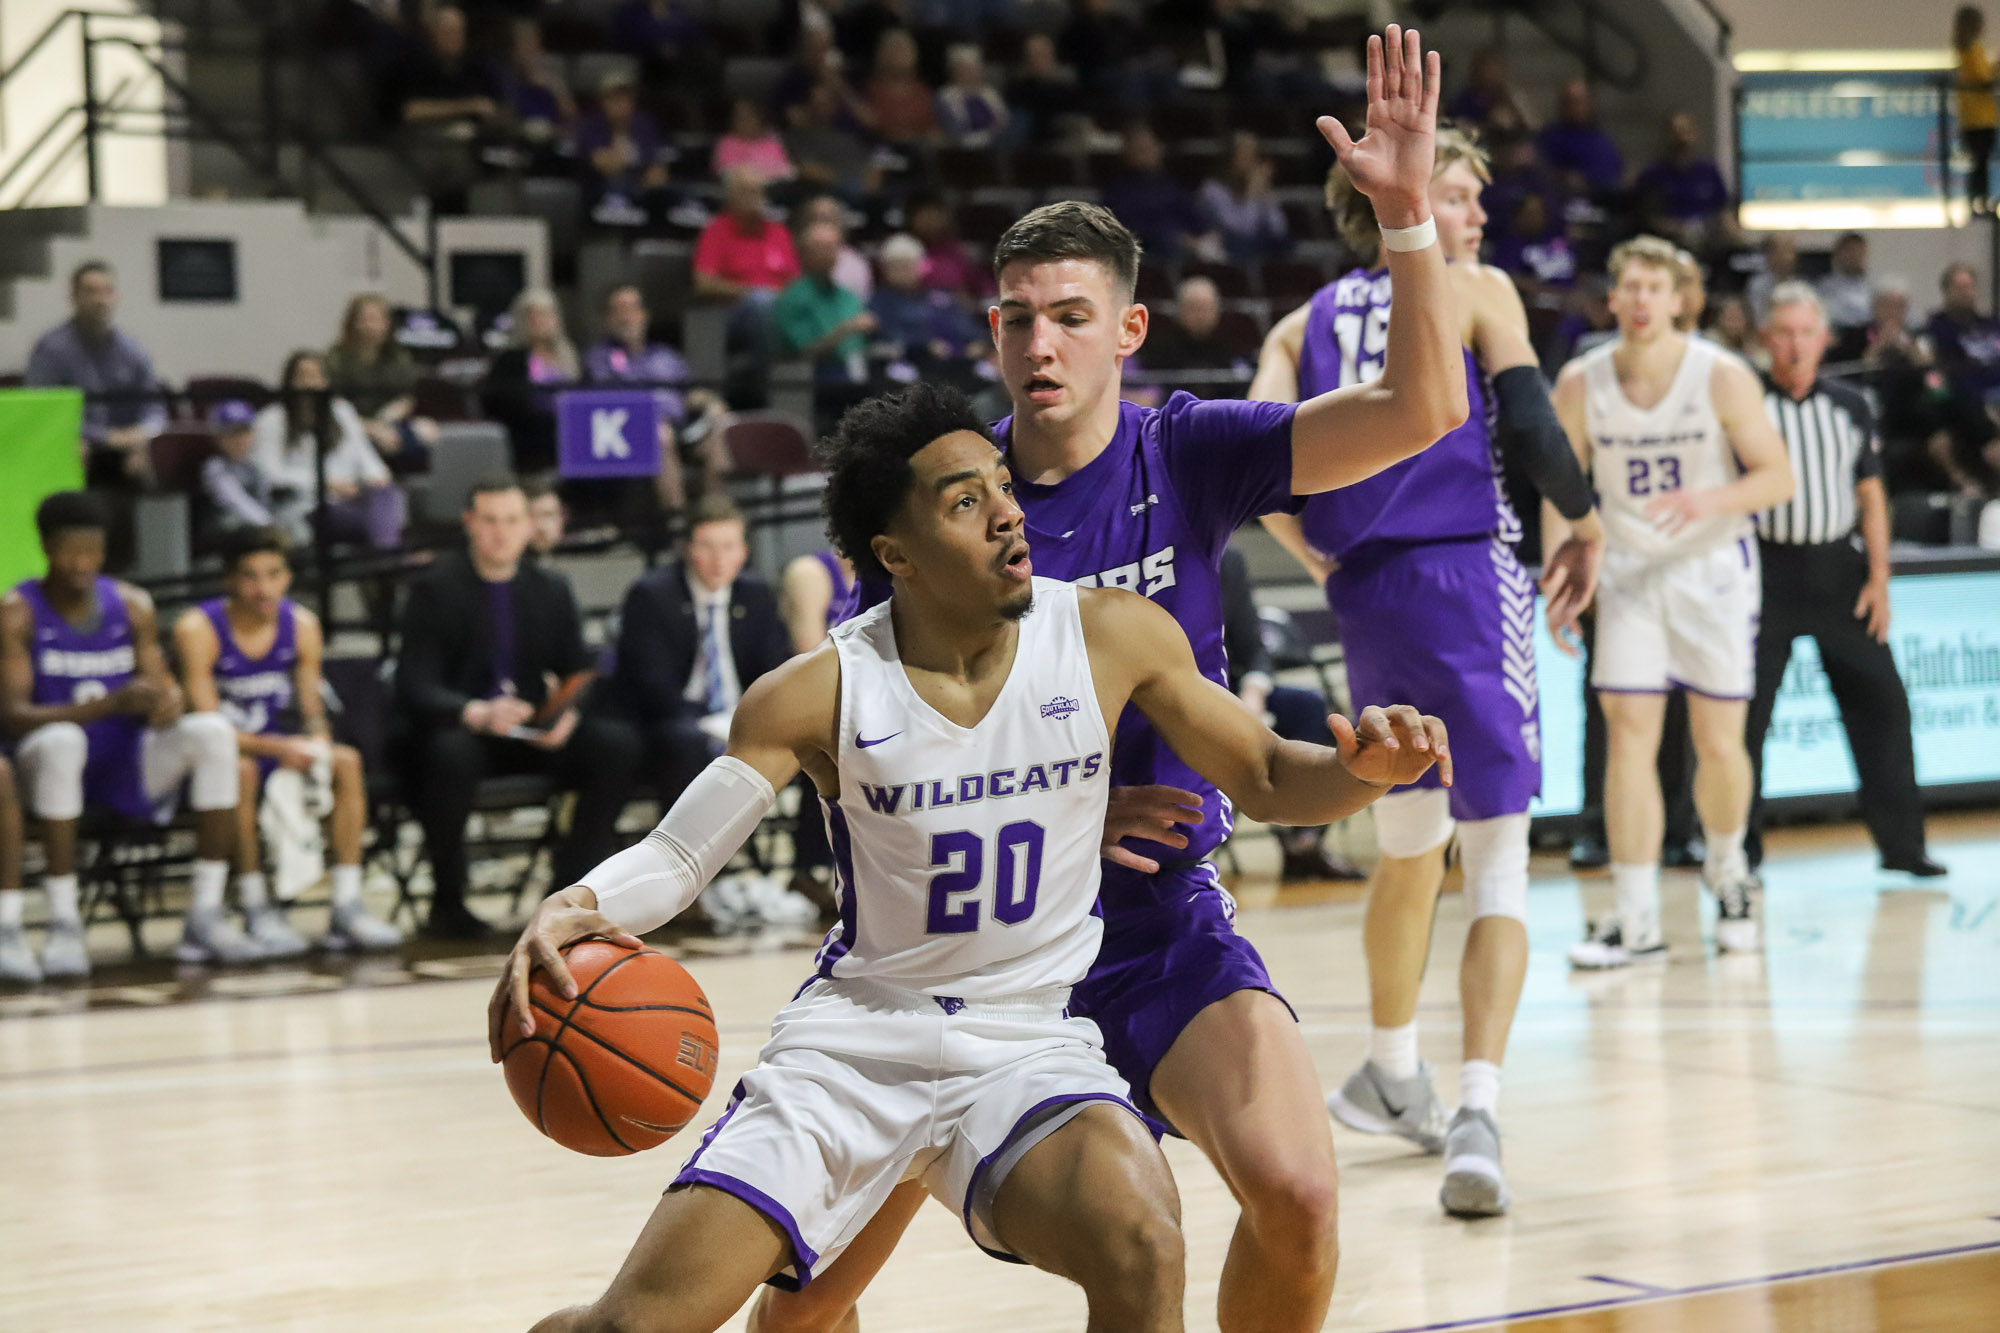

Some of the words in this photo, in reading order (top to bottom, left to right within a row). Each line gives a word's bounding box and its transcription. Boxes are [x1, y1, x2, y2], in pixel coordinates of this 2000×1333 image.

[592, 408, 631, 459] K
[1627, 457, 1682, 496] 23
[858, 751, 1103, 816] WILDCATS
[924, 818, 1046, 936] 20
